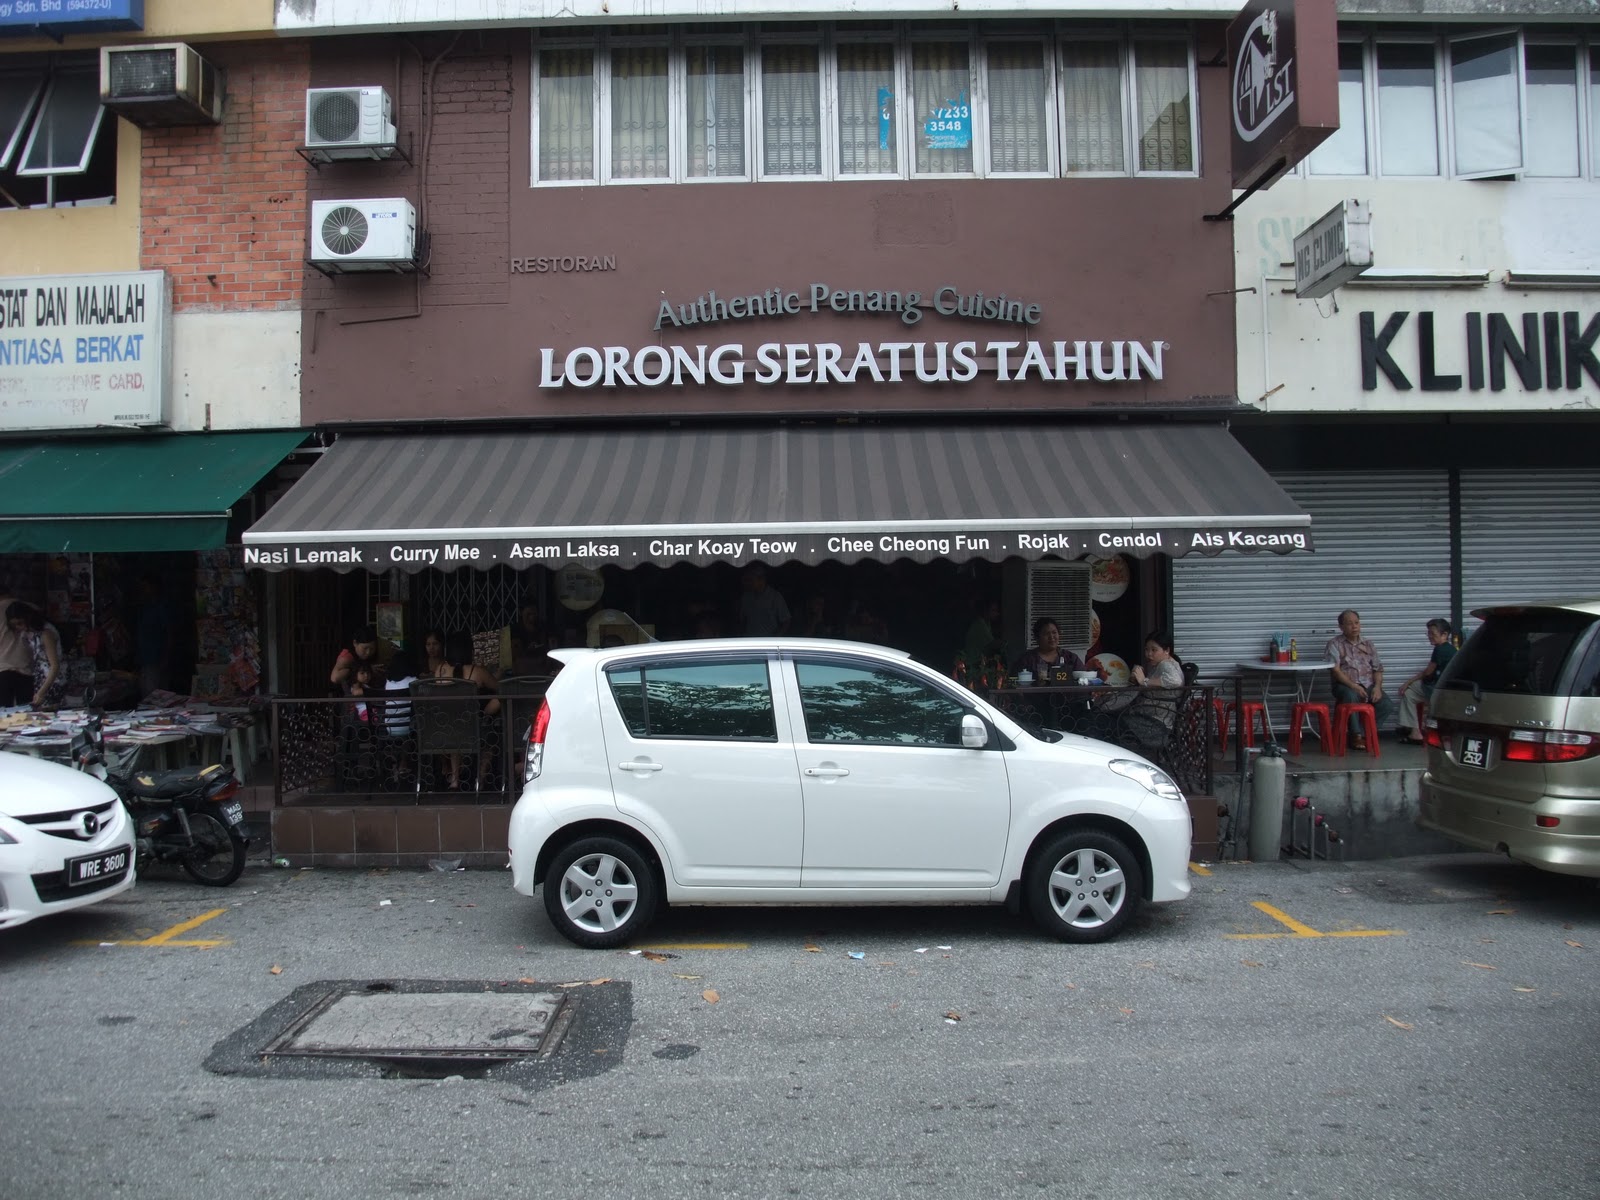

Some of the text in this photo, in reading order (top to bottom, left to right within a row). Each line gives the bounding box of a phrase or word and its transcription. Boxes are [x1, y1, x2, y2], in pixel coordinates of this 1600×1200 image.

[16, 1, 38, 13] Sdn.
[41, 0, 61, 11] Bhd
[1266, 57, 1293, 114] LST
[930, 120, 962, 132] 3548
[1313, 220, 1343, 271] CLINIC
[510, 255, 617, 273] RESTORAN
[36, 287, 67, 327] DAN
[76, 283, 145, 325] MAJALAH
[653, 283, 1042, 331] Authentic Penang Cuisine
[75, 334, 144, 364] BERKAT
[538, 340, 1165, 388] LORONG SERATUS TAHUN
[1359, 310, 1600, 391] KLINIK
[244, 531, 1306, 564] Nasi Lemak Curry Mee Asam Laksa Char Koay Teow Chee Cheong Fun Rojak Cendol Ais Kacang
[1056, 672, 1067, 681] 52
[80, 852, 125, 879] WRE 3600
